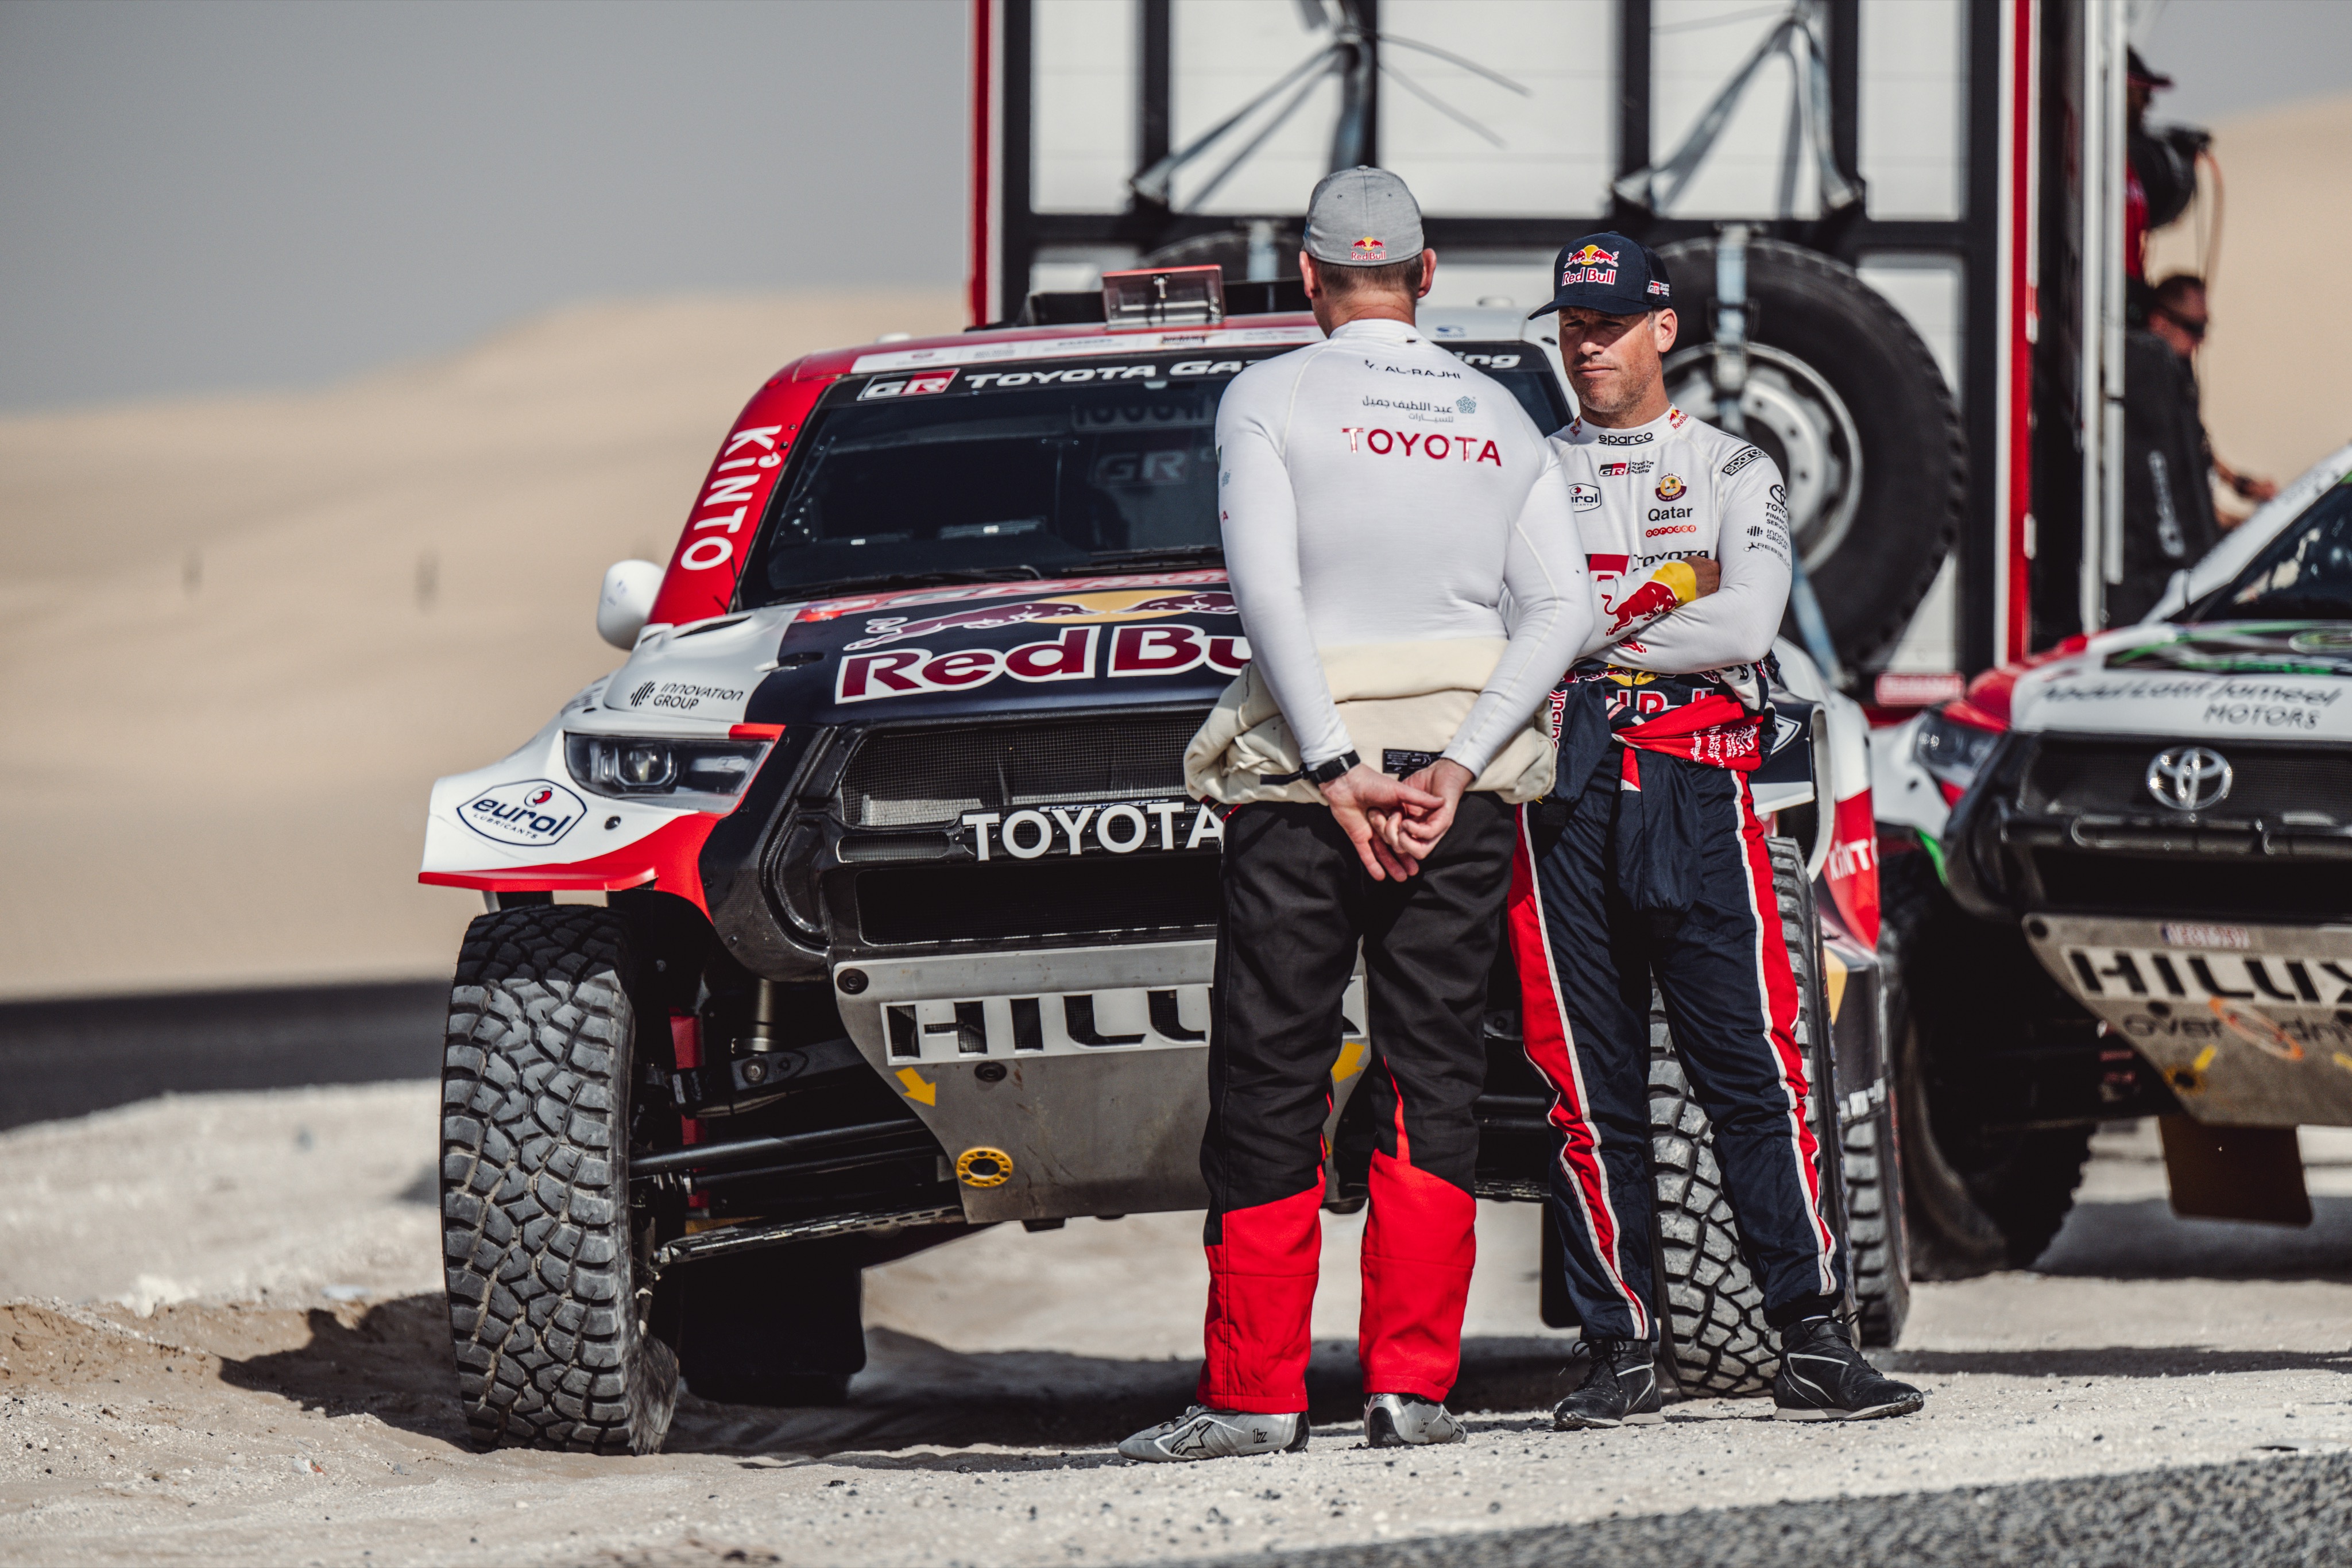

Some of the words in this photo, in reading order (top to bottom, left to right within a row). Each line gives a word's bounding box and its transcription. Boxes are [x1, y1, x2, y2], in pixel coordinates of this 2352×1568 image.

[1351, 251, 1366, 260] Red
[1368, 250, 1386, 260] Bull
[1561, 268, 1583, 287] Red
[1585, 267, 1616, 285] Bull
[1454, 351, 1521, 369] ing
[860, 373, 950, 400] GR
[965, 365, 1156, 389] TOYOTA
[1385, 366, 1462, 380] AL-RAJHI
[1672, 417, 1684, 429] Red
[1342, 428, 1502, 467] TOYOTA
[1598, 432, 1654, 446] sparco
[1599, 465, 1626, 477] GR
[1724, 450, 1766, 474] sparco
[1571, 493, 1597, 504] rol
[1648, 506, 1693, 521] Qatar
[1646, 525, 1696, 537] ooredoo
[835, 625, 1101, 704] Red
[1108, 624, 1252, 677] Bu
[653, 694, 699, 711] GROUP
[2203, 703, 2320, 730] MOTORS
[472, 799, 572, 837] eurol
[473, 812, 538, 839] LUBRICANTS
[962, 802, 1225, 862] TOYOTA
[887, 986, 1213, 1062] HILU
